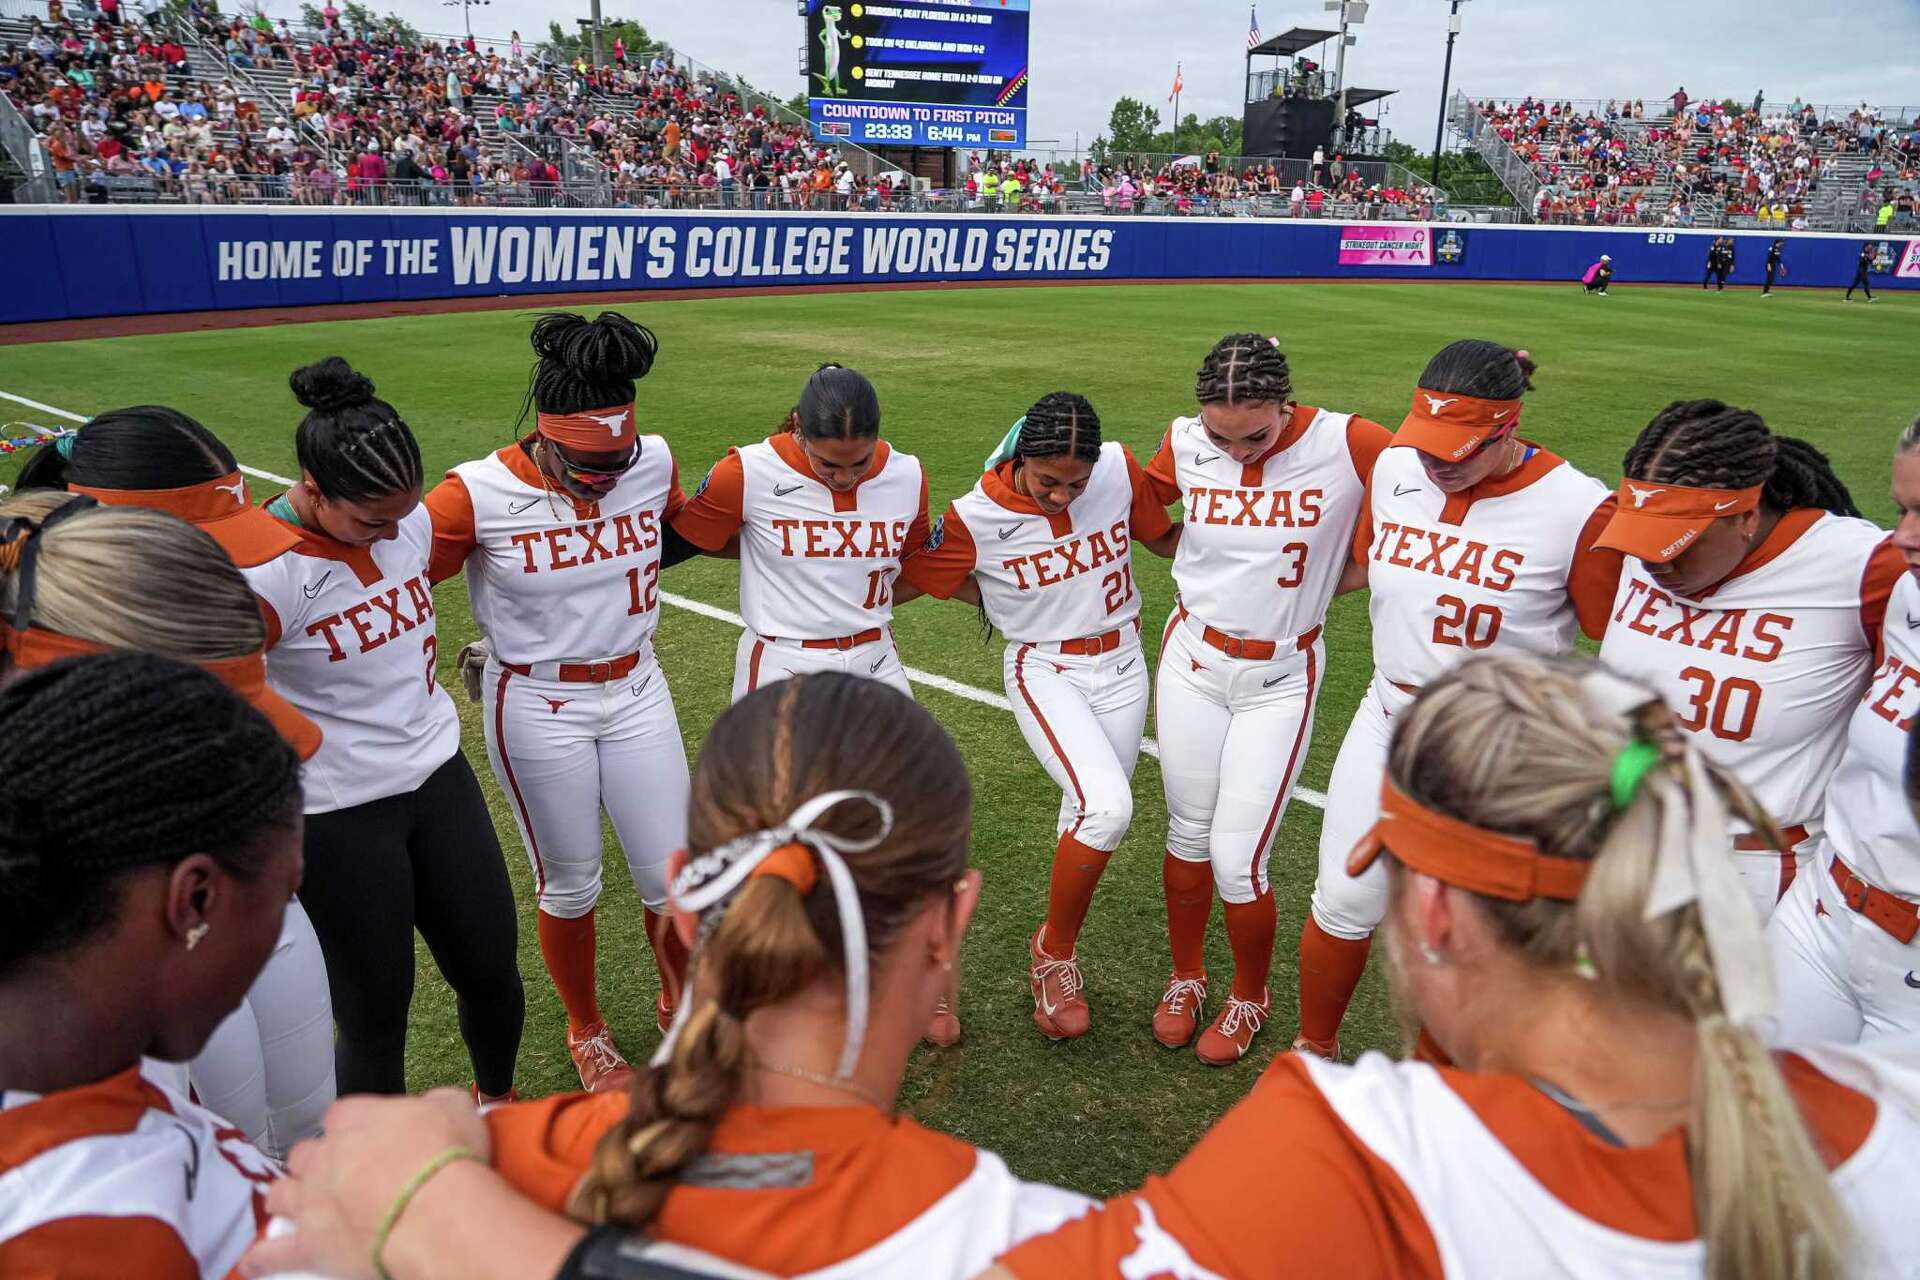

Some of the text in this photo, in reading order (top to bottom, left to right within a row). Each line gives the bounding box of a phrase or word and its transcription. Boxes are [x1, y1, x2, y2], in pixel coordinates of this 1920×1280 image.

[973, 44, 985, 54] 4-2
[823, 104, 1015, 125] COUNTDOWN TO FIRST PITCH
[865, 123, 912, 139] 23:33
[927, 126, 981, 143] 6:44 PM
[218, 225, 1113, 285] HOME OF THE WOMEN'S COLLEGE WORLD SERIES
[1345, 241, 1424, 250] STRIKEOUT CANCER NIGHT
[1648, 233, 1675, 244] 220
[1188, 487, 1324, 528] TEXAS
[512, 510, 660, 574] TEXAS
[772, 520, 906, 558] TEXAS
[1003, 520, 1130, 591] TEXAS
[1277, 542, 1309, 588] 3
[1372, 522, 1526, 592] TEXAS
[625, 559, 660, 617] 12
[1102, 562, 1134, 616] 21
[305, 570, 435, 662] TEXA
[1432, 594, 1503, 650] 20
[1614, 577, 1794, 663] TEXAS
[1674, 665, 1762, 742] 30
